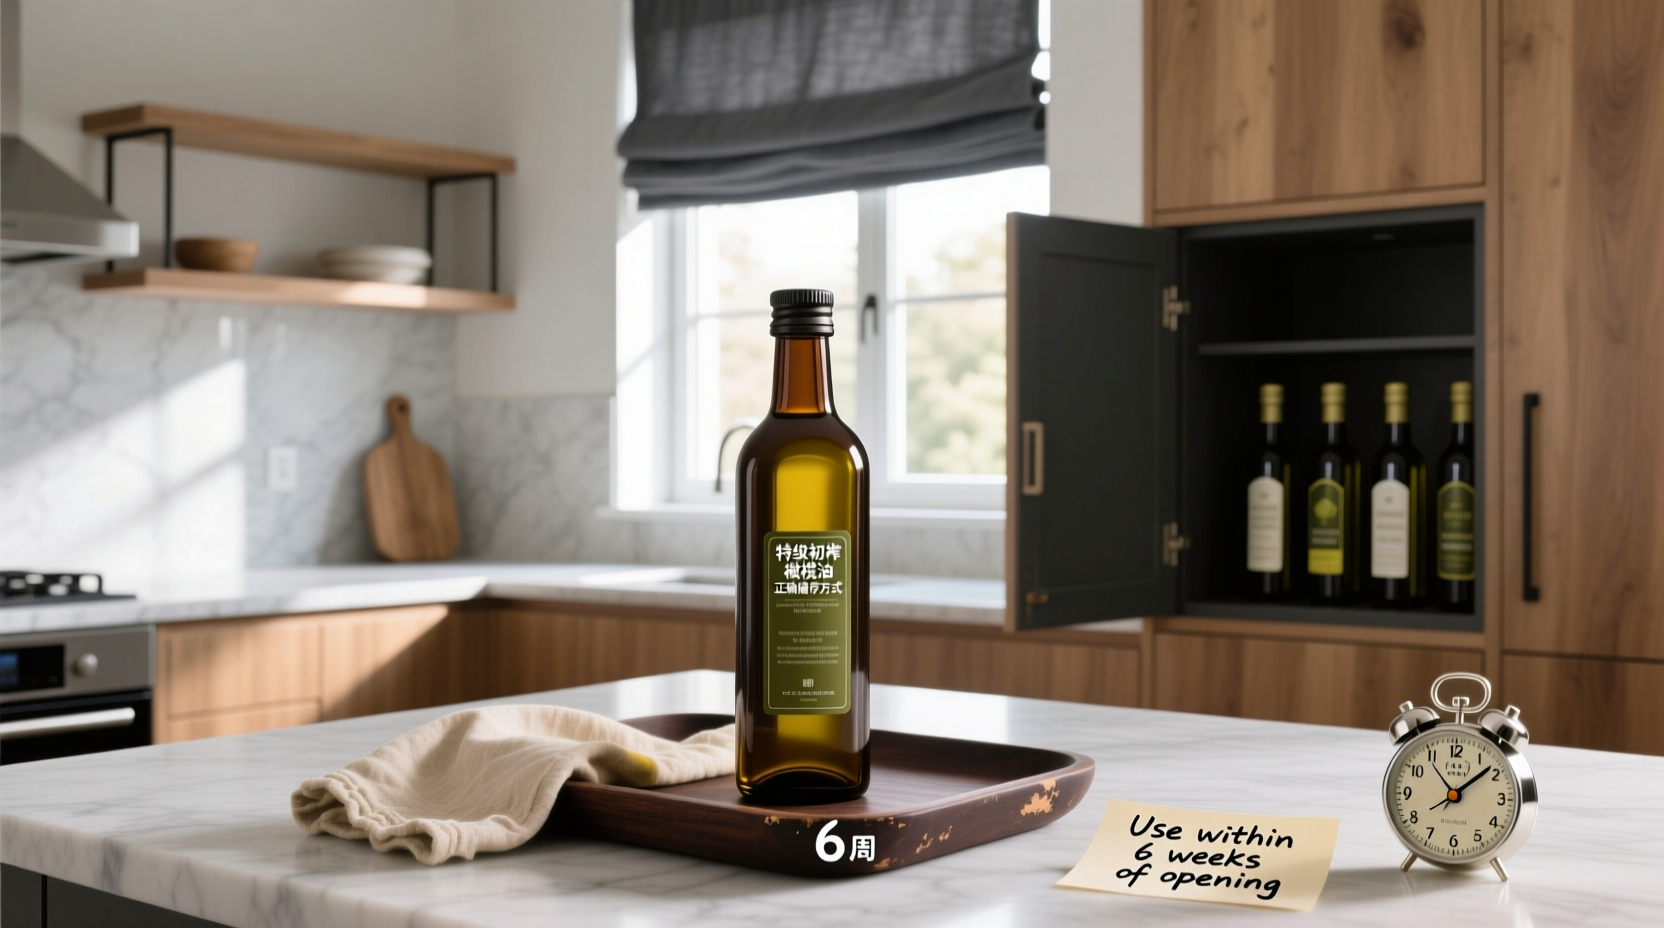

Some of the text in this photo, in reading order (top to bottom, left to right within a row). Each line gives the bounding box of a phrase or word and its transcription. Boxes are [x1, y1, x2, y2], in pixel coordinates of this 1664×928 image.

[1428, 749, 1437, 763] 11
[1450, 744, 1464, 758] 12
[1411, 764, 1424, 778] 10
[1491, 768, 1500, 782] 2
[1403, 786, 1412, 800] 9
[1497, 792, 1506, 806] 3
[1409, 810, 1418, 824] 8
[1488, 815, 1498, 828] 4
[1129, 814, 1294, 849] Use within
[1426, 827, 1435, 840] 7
[1473, 829, 1482, 842] 5
[1449, 834, 1458, 848] 6
[1134, 842, 1261, 869] 6 weeks
[1115, 863, 1282, 901] of opening
